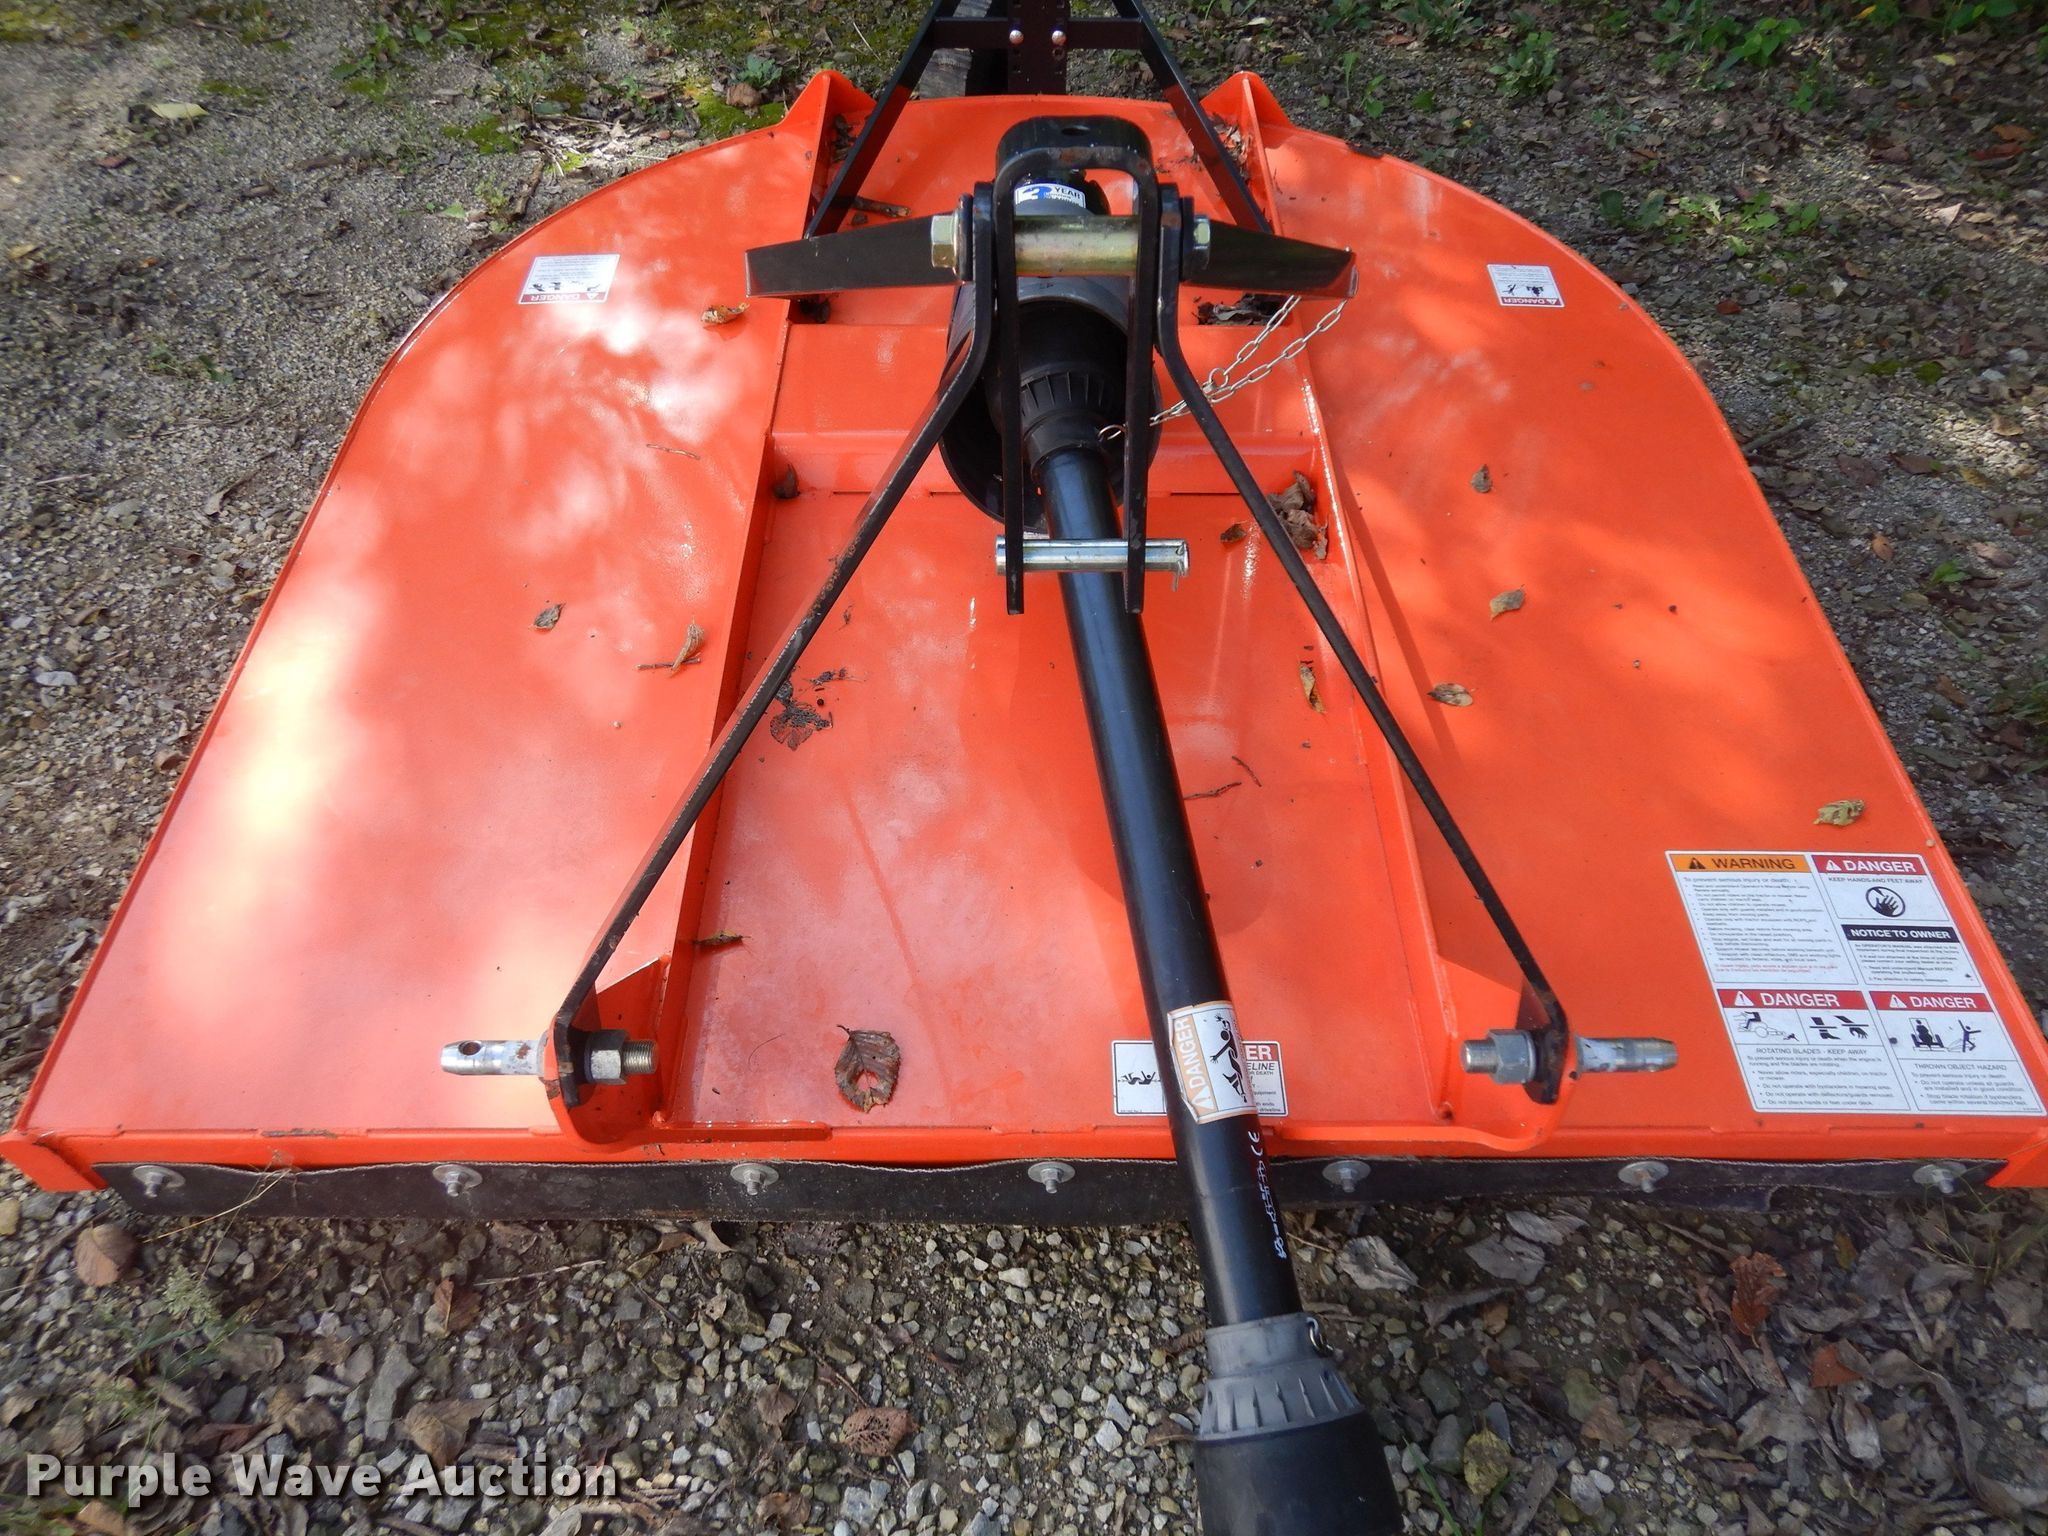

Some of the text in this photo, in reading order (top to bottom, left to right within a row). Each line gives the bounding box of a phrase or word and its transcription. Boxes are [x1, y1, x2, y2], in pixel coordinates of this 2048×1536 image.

[1711, 858, 1796, 870] WARNING
[1843, 860, 1917, 873] DANGER
[1851, 928, 1892, 938] NOTICE
[1911, 930, 1951, 939] OWNER
[1760, 992, 1840, 1006] DANGER
[1909, 996, 1978, 1008] DANGER
[1174, 1018, 1207, 1089] DANGER
[1245, 1045, 1272, 1060] ER
[1248, 1131, 1263, 1156] CE
